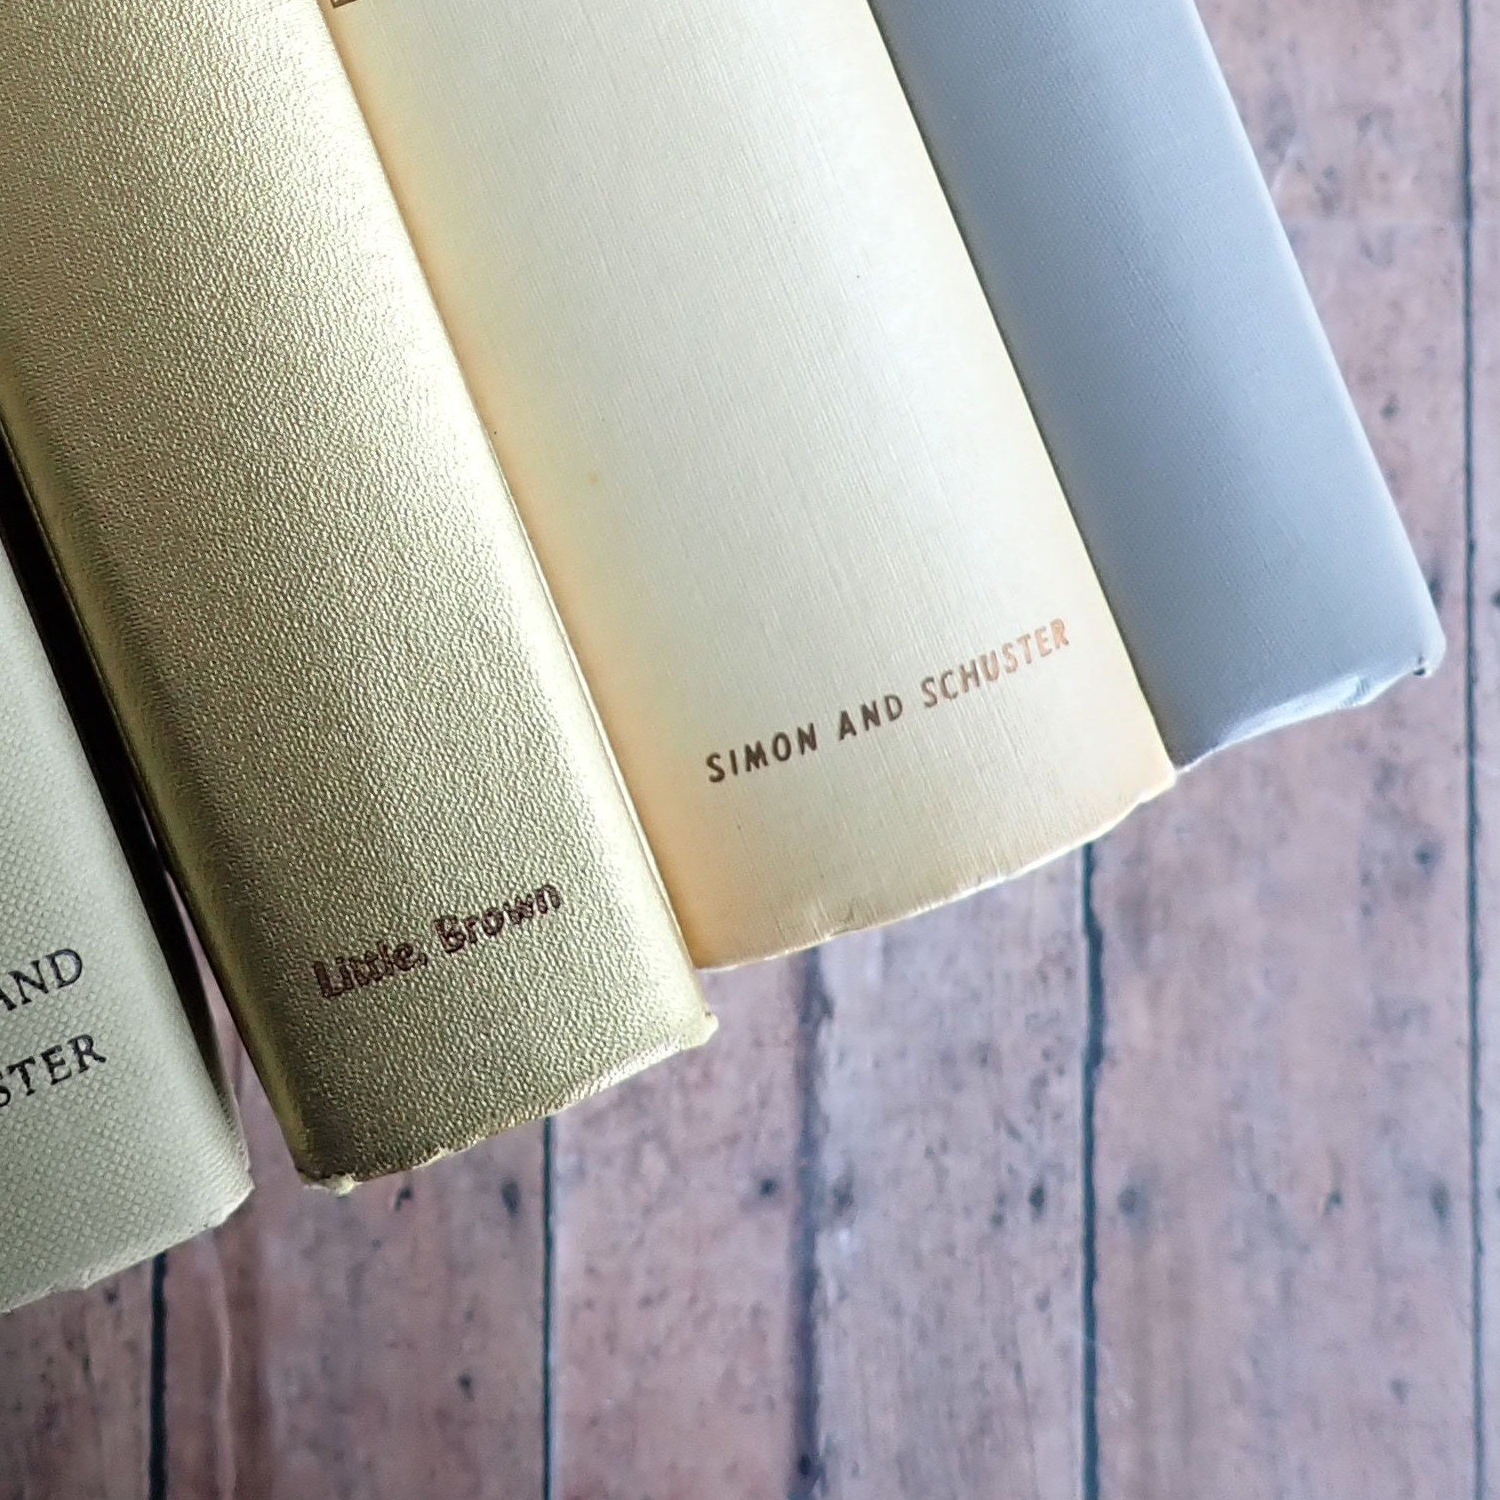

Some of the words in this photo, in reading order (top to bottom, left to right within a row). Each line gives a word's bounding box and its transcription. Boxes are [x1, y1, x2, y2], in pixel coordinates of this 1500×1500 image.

[705, 722, 818, 783] SIMON
[838, 693, 904, 741] AND
[921, 617, 1070, 708] SCHUSTER
[433, 884, 562, 953] Brown
